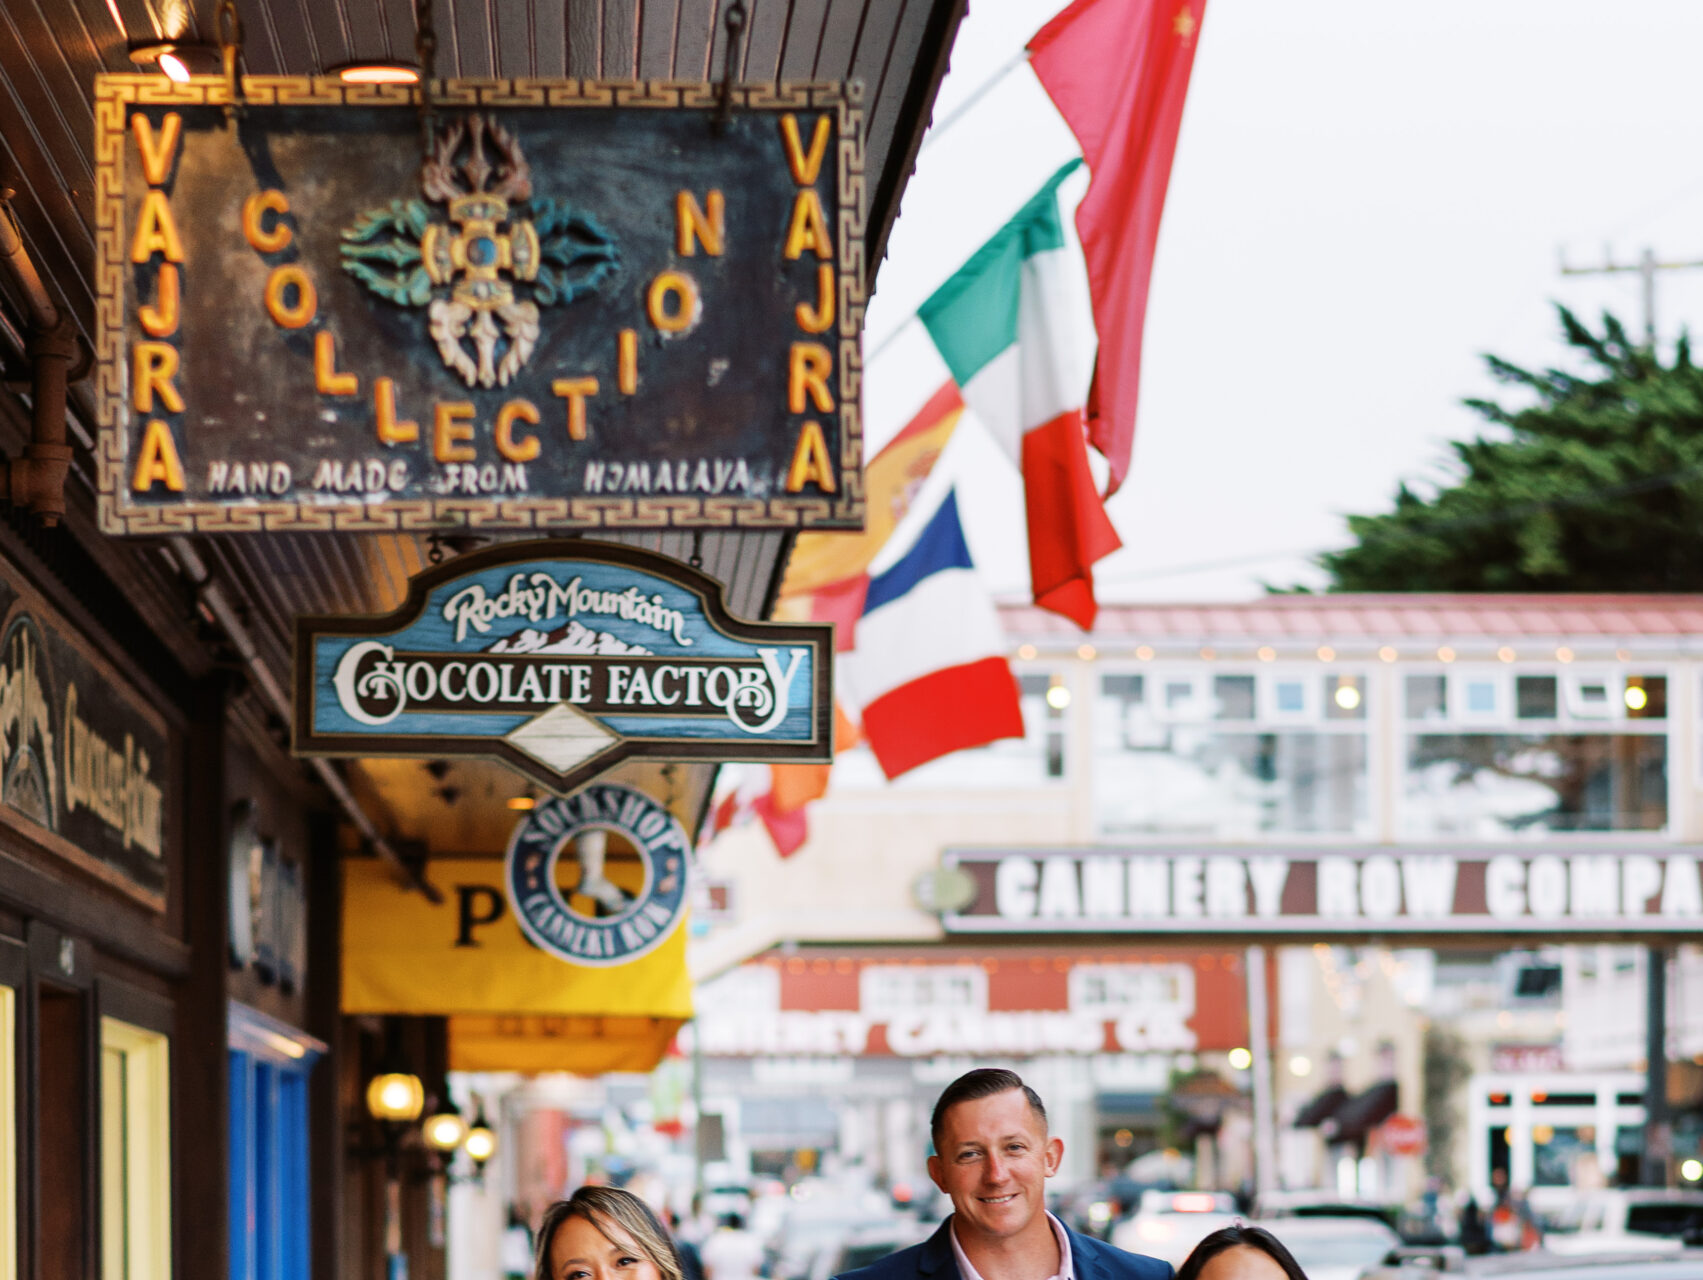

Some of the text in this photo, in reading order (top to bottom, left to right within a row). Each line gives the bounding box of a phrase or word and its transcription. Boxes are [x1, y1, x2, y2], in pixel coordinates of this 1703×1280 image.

[131, 112, 186, 494] VAJRA
[243, 189, 726, 462] COLLECTION
[780, 112, 836, 495] VAJRA
[207, 457, 750, 494] HAND MADE FROM HIMALAYA
[443, 573, 693, 646] Rocky Mountain
[333, 641, 808, 734] CHOCOLATE FACTORY
[995, 854, 1291, 923] CANNERY
[1316, 853, 1459, 921] ROW
